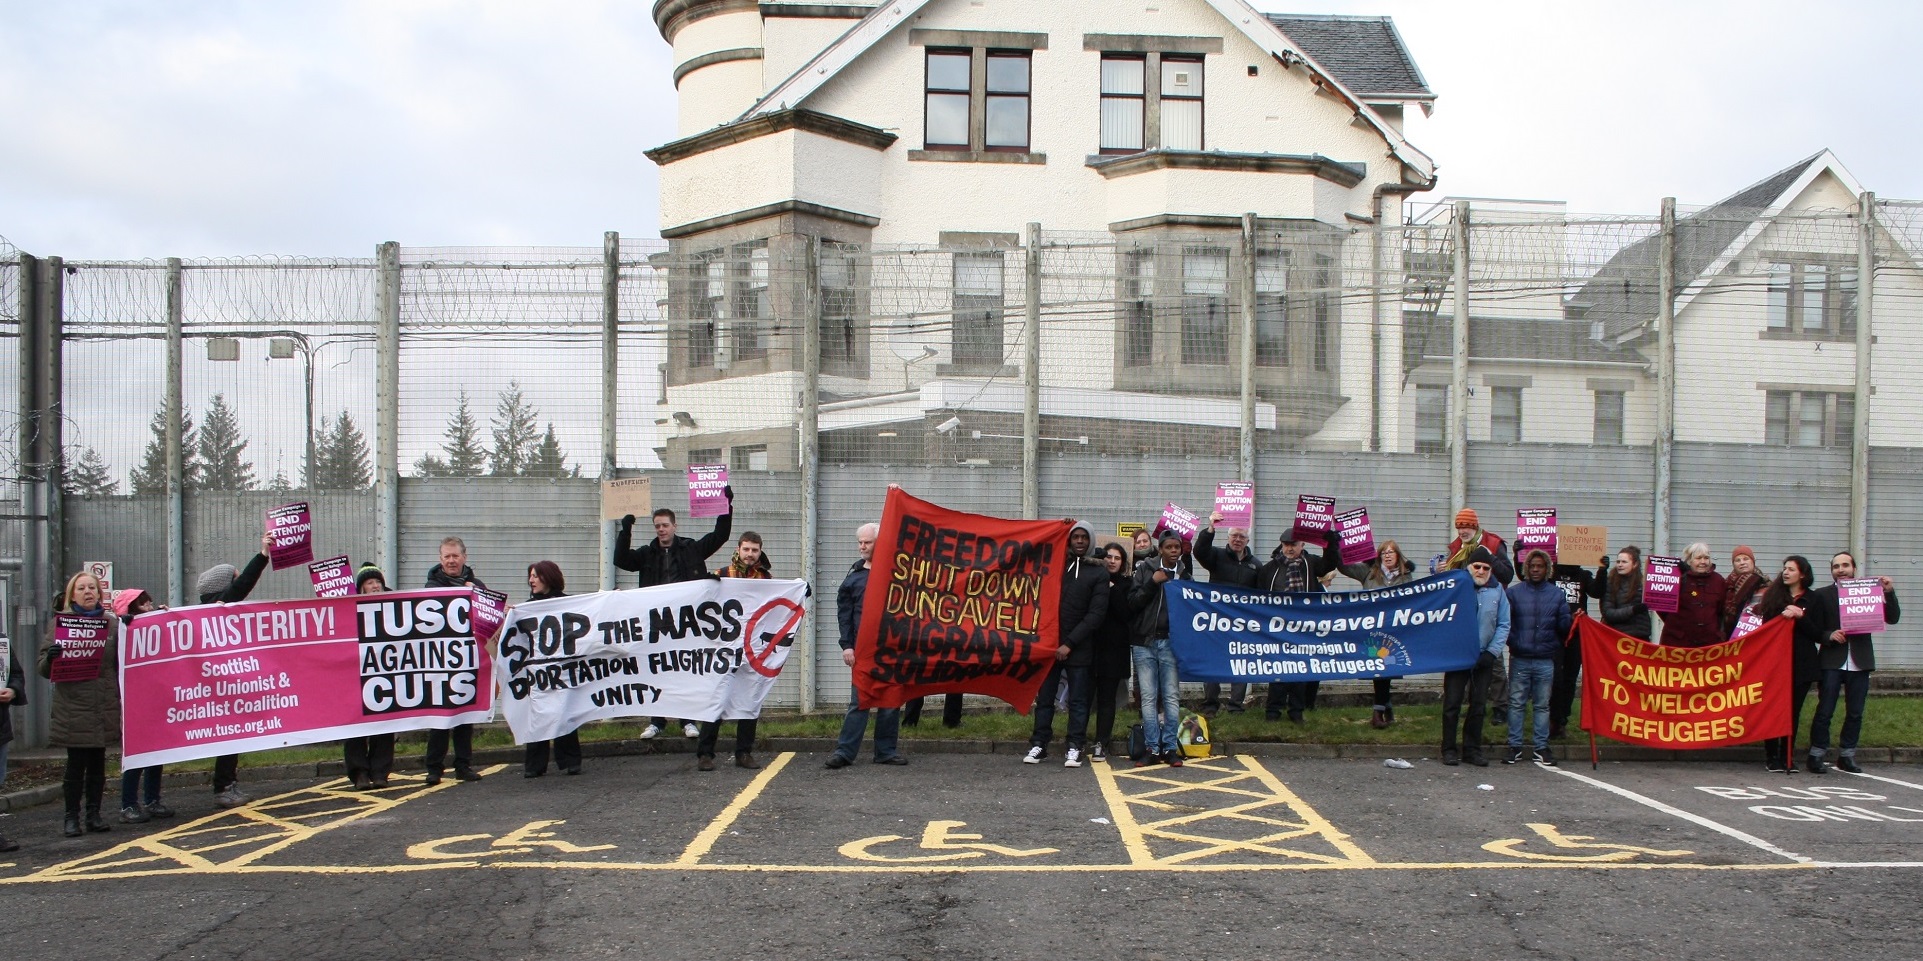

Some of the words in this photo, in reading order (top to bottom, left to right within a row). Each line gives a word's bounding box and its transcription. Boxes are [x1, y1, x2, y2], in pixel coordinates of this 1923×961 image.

[690, 481, 727, 489] DETENTION
[276, 515, 299, 526] END
[1163, 510, 1197, 530] DETENTION
[1173, 510, 1191, 521] END
[1296, 512, 1332, 521] DETENTION
[1343, 518, 1361, 528] END
[268, 523, 311, 537] ETENTION
[1165, 520, 1189, 535] NOW
[1300, 520, 1326, 529] NOW
[1339, 524, 1370, 538] ETENTION
[1517, 526, 1556, 534] DETENTION
[276, 534, 304, 547] NOW
[897, 515, 1053, 575] FREEDOM!
[1344, 534, 1366, 545] NOW
[319, 568, 341, 580] END
[1655, 566, 1672, 574] END
[314, 575, 354, 592] DETENTION
[894, 553, 961, 592] SHUT
[966, 569, 1040, 604] DOWN
[1646, 574, 1679, 584] DETENTION
[321, 587, 348, 597] NOW
[1183, 588, 1203, 600] No
[1210, 590, 1292, 605] Detention
[1321, 594, 1342, 605] No
[1349, 578, 1455, 603] Deportations
[1651, 583, 1674, 592] NOW
[478, 596, 496, 607] END
[1839, 596, 1882, 605] DETENTION
[472, 600, 504, 618] DETENTION
[886, 583, 1040, 635] DUNGAVEL!
[1847, 605, 1875, 614] NOW
[357, 598, 470, 638] TUSC
[478, 611, 499, 624] NOW
[1192, 612, 1261, 632] Close
[1268, 611, 1384, 637] Dungavel
[1392, 604, 1457, 627] Now!
[131, 624, 161, 659] NO
[166, 619, 193, 652] TO
[201, 606, 334, 649] AUSTERITY!
[1736, 620, 1758, 631] DETEN
[68, 629, 96, 638] END
[501, 612, 591, 678] STOP
[598, 617, 643, 644] THE
[649, 599, 743, 643] MASS
[877, 612, 1040, 666] MIGRANT
[62, 649, 96, 658] NOW
[1229, 641, 1279, 656] Glasgow
[1282, 642, 1343, 656] Campaign
[1344, 642, 1356, 653] to
[1616, 637, 1745, 664] GLASGOW
[362, 640, 475, 674] AGAINST
[648, 648, 743, 676] FLIGHTS!
[202, 656, 260, 678] Scottish
[1230, 659, 1307, 676] Welcome
[1310, 658, 1385, 674] Refugees
[1616, 661, 1742, 688] CAMPAIGN
[174, 683, 212, 702] Trade
[216, 675, 276, 696] Unionist
[278, 672, 290, 688] &
[362, 672, 476, 712] CUTS
[591, 683, 662, 707] UNITY
[1600, 678, 1630, 706] TO
[1640, 682, 1763, 714] WELCOME
[166, 701, 230, 724] Socialist
[233, 694, 299, 714] Coalition
[185, 716, 282, 740] www.tusc.org.uk
[1611, 712, 1745, 742] REFUGEES
[1694, 786, 1887, 800] BUS
